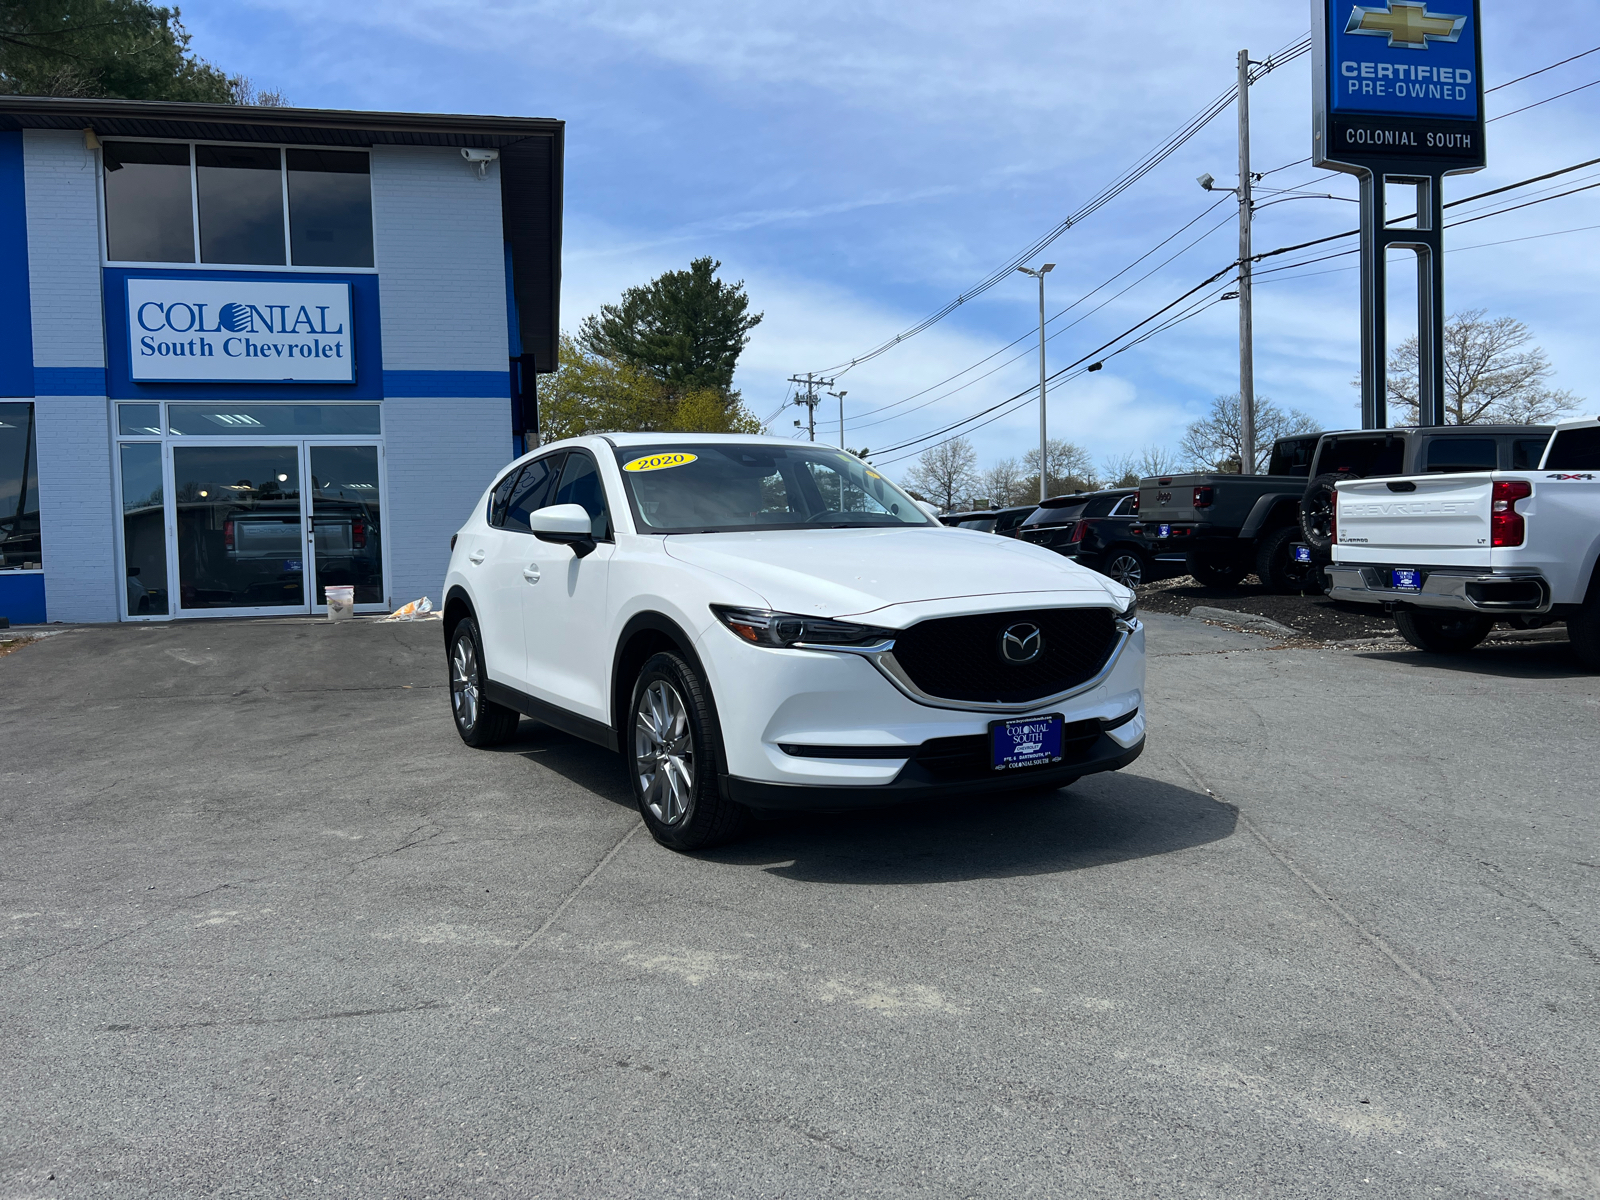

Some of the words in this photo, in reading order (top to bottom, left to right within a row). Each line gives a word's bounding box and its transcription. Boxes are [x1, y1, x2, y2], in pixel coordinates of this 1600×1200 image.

[1341, 61, 1472, 84] CERTIFIED
[1348, 80, 1466, 101] PRE-OWNED
[1346, 129, 1418, 146] COLONIAL
[1426, 132, 1471, 148] SOUTH
[137, 302, 343, 335] COLONIAL
[140, 336, 214, 357] South
[222, 337, 343, 359] Chevrolet
[638, 454, 685, 470] 2020
[1156, 490, 1172, 503] Jeep
[1342, 501, 1475, 516] CHEVROLET
[1006, 724, 1049, 736] COLONIAL
[1013, 733, 1042, 744] SOUTH
[1008, 760, 1033, 769] COLONIAL
